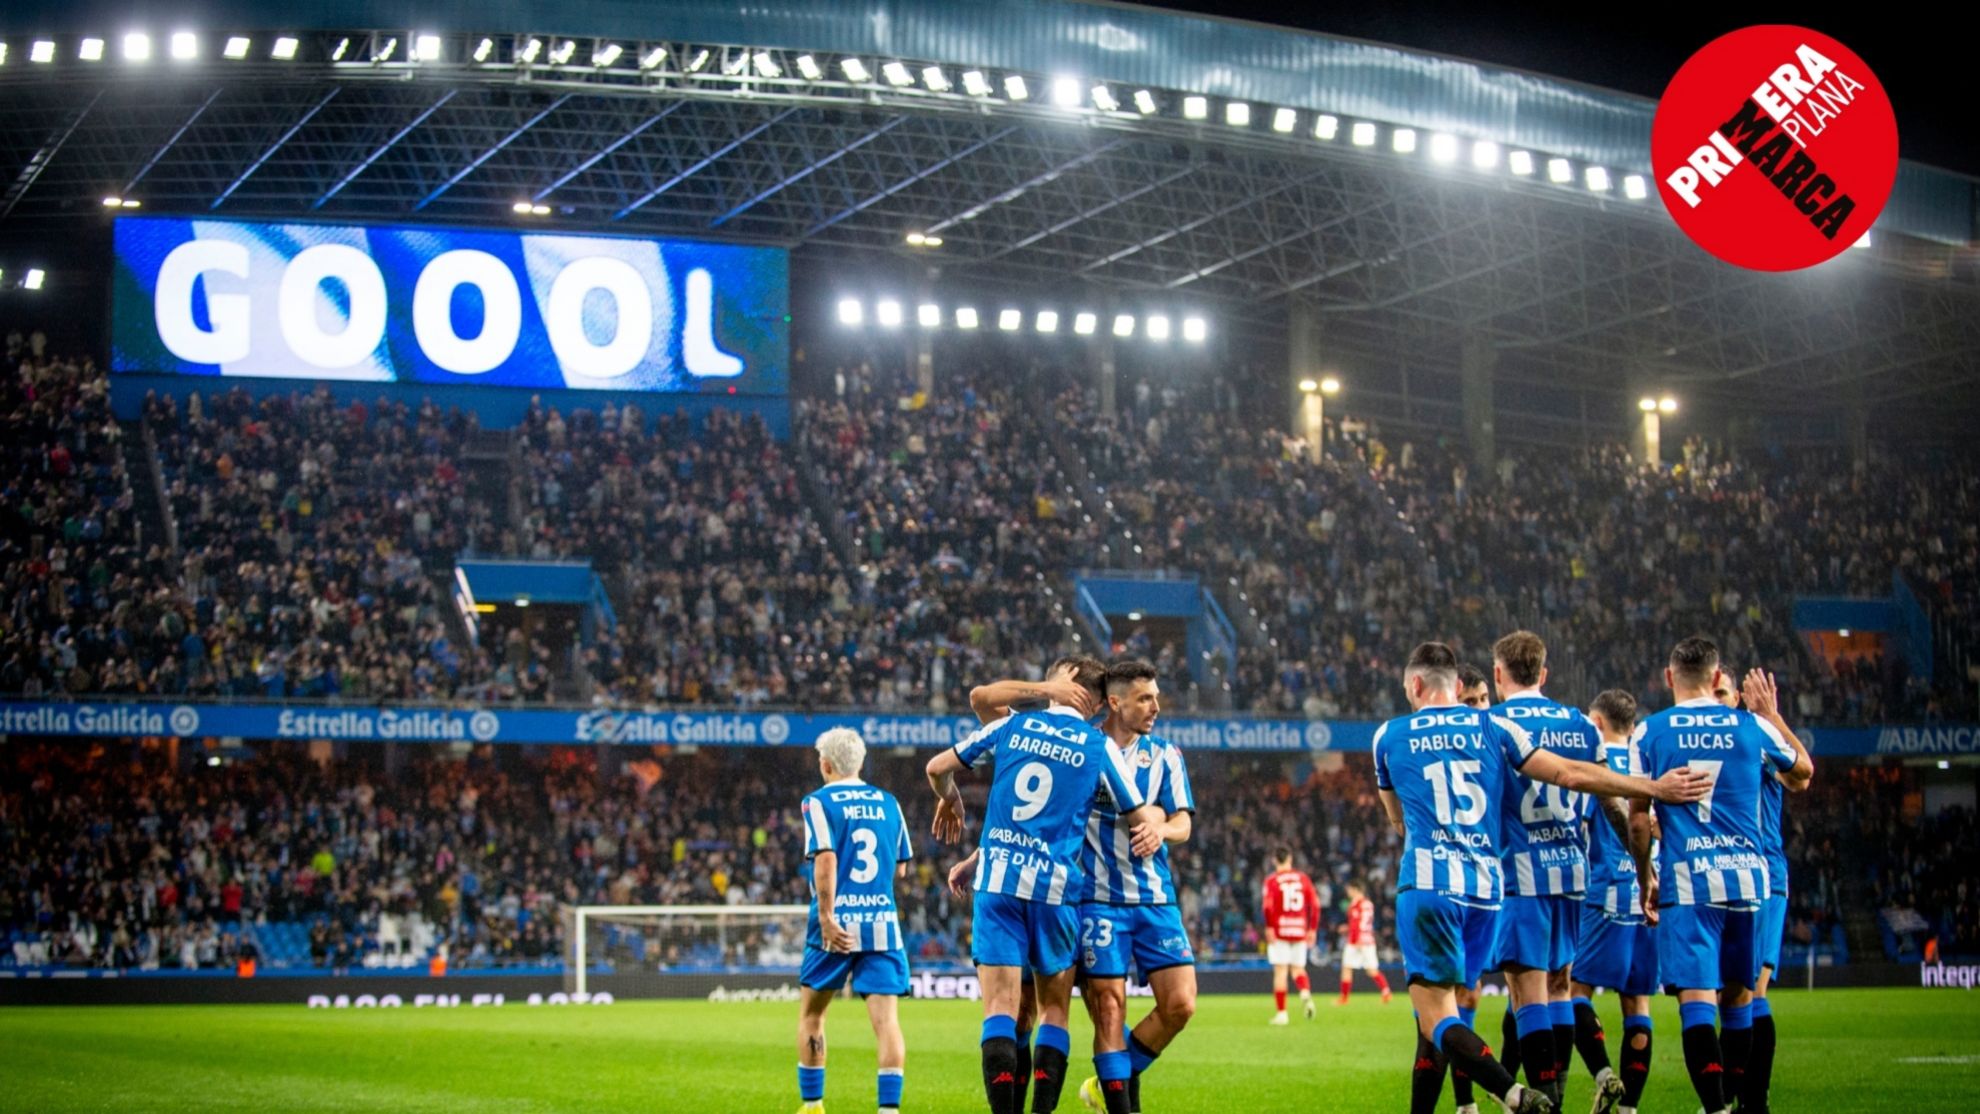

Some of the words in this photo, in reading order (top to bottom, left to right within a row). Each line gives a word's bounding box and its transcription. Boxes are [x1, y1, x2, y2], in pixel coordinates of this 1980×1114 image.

[154, 238, 743, 379] GOOOL
[75, 706, 163, 733] Galicia
[278, 709, 373, 737] Estrella
[376, 709, 464, 739] Galicia
[1410, 713, 1480, 731] DIGI
[1506, 706, 1571, 720] DIGI
[1669, 714, 1738, 727] DIGI
[671, 714, 756, 742] Galicia
[863, 717, 949, 745] Estrella
[1023, 718, 1088, 745] DIGI
[1224, 721, 1300, 748] Galicia
[1539, 727, 1588, 748] ÁNGEL
[1678, 733, 1734, 749] LUCAS
[1008, 734, 1085, 768] BARBERO
[1409, 733, 1467, 754] PABLO
[830, 790, 884, 802] DIGI
[1012, 761, 1053, 822] 9
[1423, 760, 1487, 826] 15
[1687, 760, 1723, 823] 7
[843, 805, 885, 821] MELLA
[850, 828, 879, 884] 3
[1279, 882, 1304, 911] 15
[1082, 917, 1113, 947] 23
